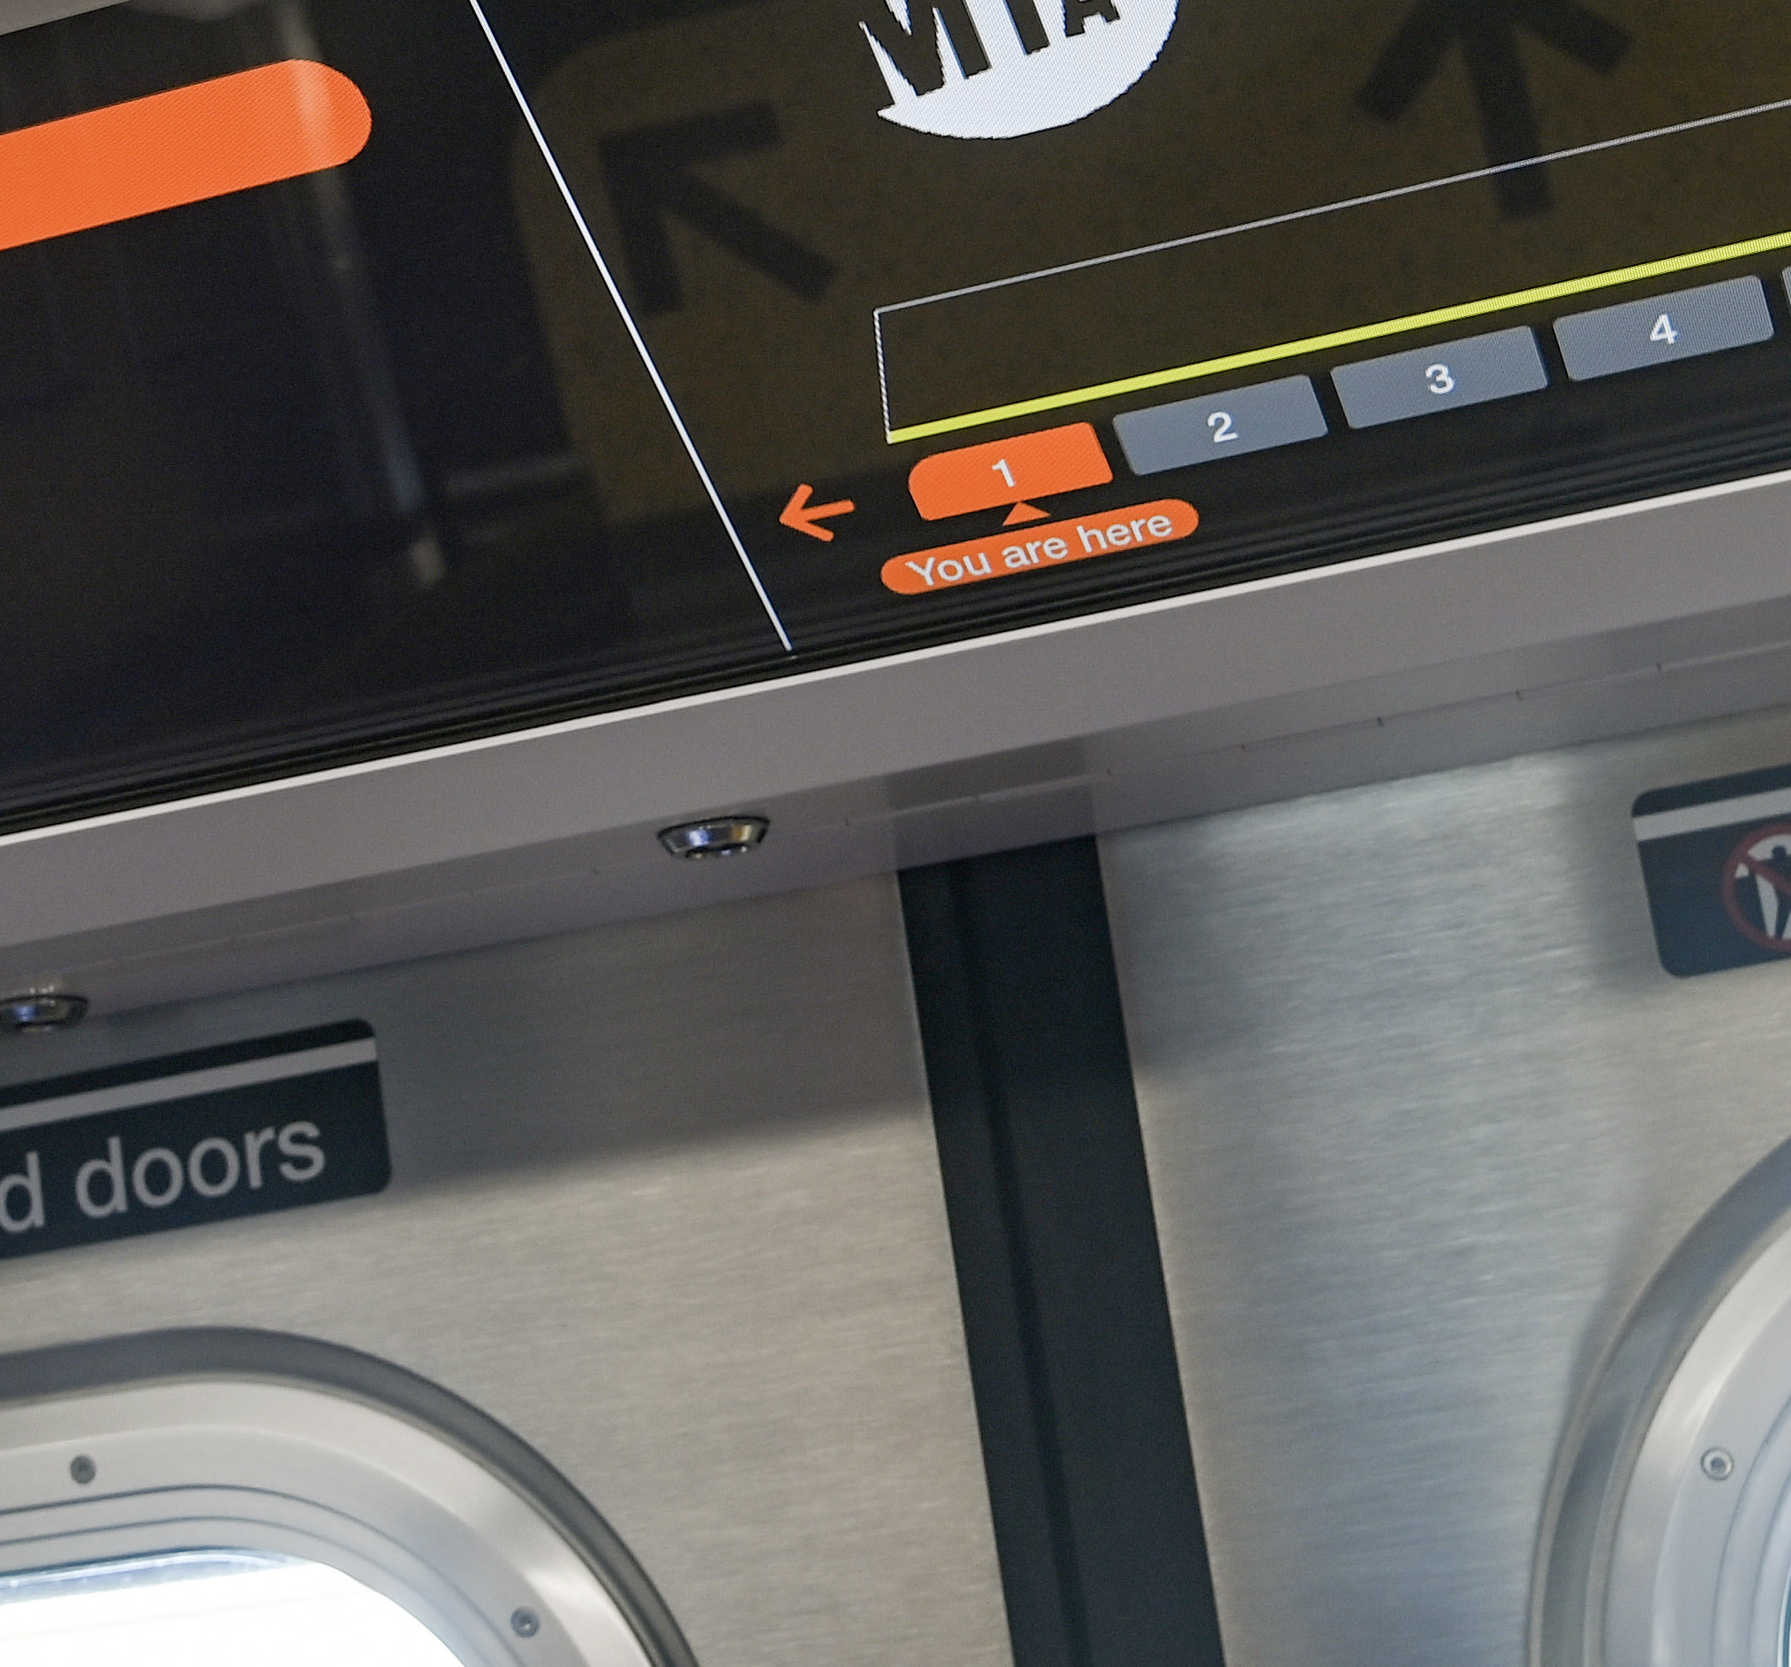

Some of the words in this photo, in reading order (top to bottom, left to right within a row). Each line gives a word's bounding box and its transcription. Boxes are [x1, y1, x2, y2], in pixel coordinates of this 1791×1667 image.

[992, 459, 1017, 488] 1
[1208, 412, 1239, 444] 2
[1424, 364, 1456, 395] 3
[1648, 314, 1678, 346] 4
[906, 549, 994, 591] You
[1003, 535, 1070, 574] are
[1077, 507, 1173, 553] here
[74, 1119, 327, 1219] doors
